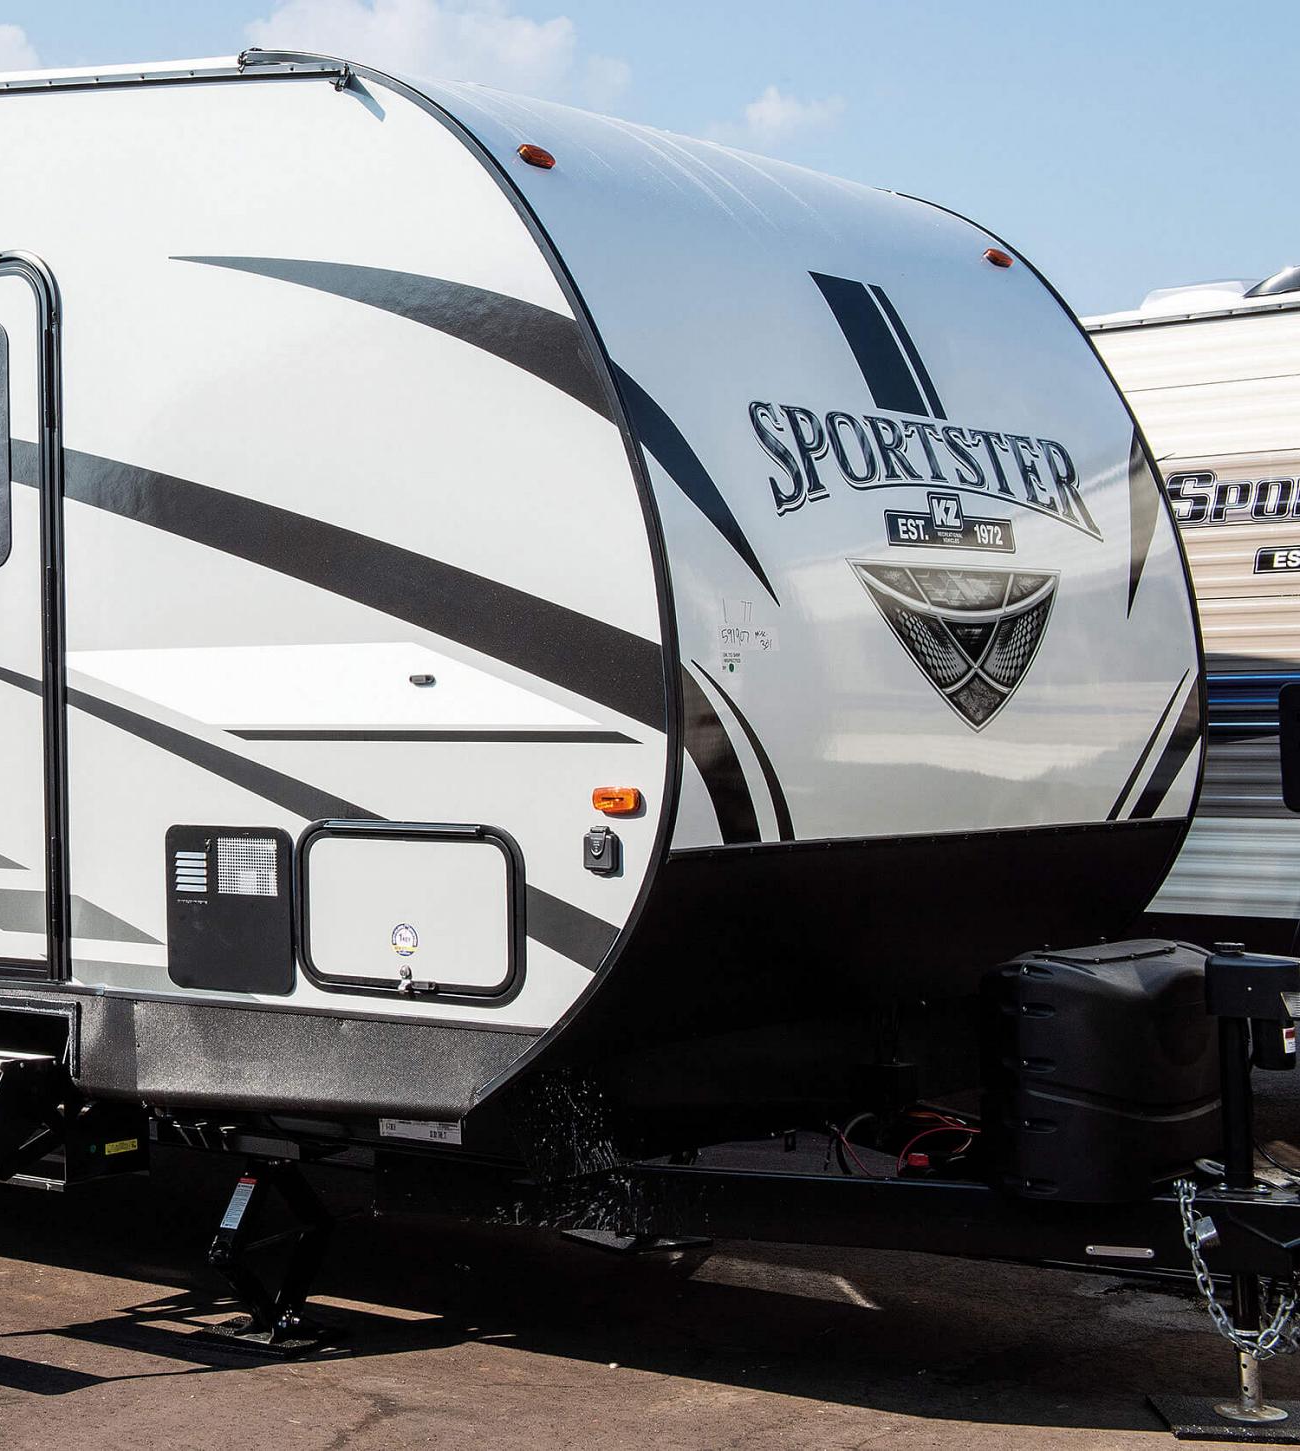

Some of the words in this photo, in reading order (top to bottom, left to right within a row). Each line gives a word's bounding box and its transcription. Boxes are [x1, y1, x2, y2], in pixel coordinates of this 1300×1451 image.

[748, 400, 1102, 541] SPORTSTER
[897, 518, 930, 541] EST.
[931, 498, 962, 527] KZ
[973, 523, 1004, 546] 1972
